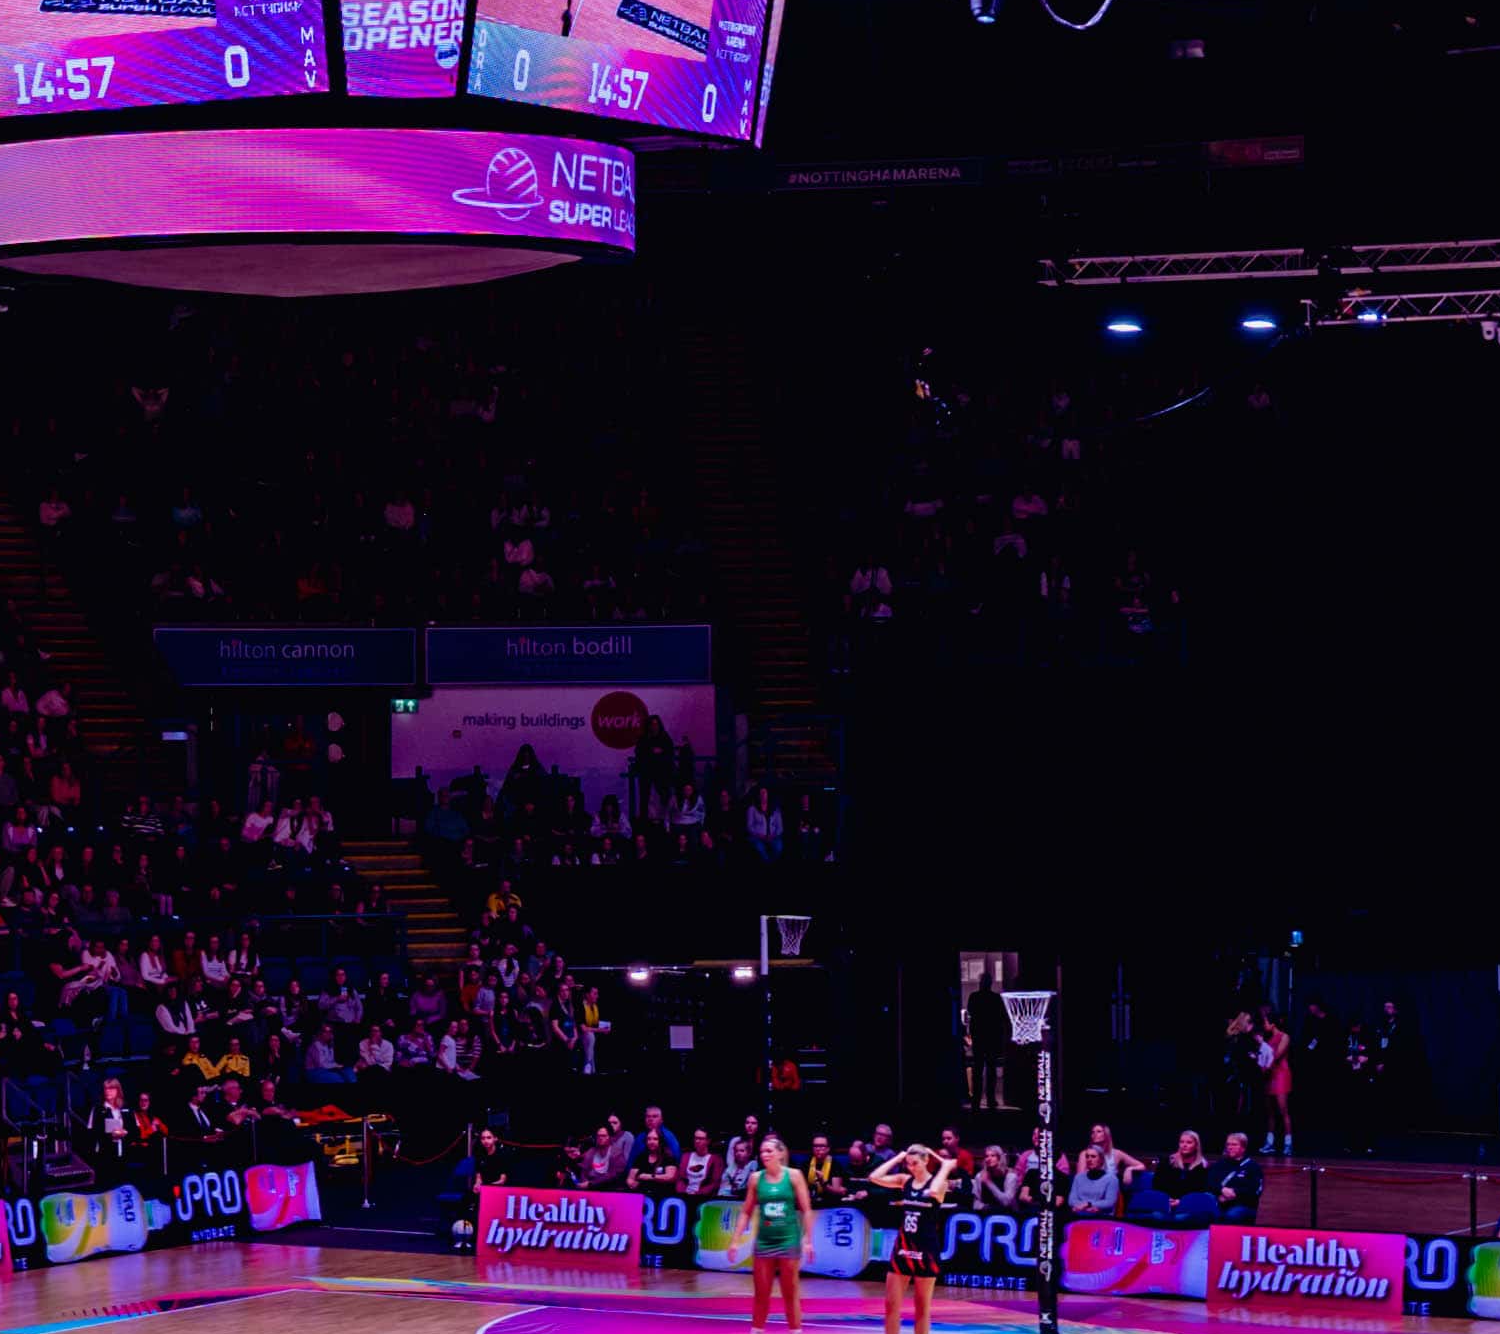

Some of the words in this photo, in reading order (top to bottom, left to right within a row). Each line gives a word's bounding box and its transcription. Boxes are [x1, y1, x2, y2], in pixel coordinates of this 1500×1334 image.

[342, 19, 465, 52] OPENER
[13, 56, 116, 105] 14:57
[223, 44, 251, 88] 0
[512, 49, 531, 92] 0
[586, 62, 650, 111] 14:57
[700, 83, 718, 123] 0
[786, 166, 961, 186] #NOTTINGHAMARENA
[548, 199, 612, 229] SUPER
[220, 639, 277, 660] hilton
[281, 643, 355, 660] cannon
[505, 635, 566, 656] hilton
[571, 635, 632, 656] bodill
[461, 713, 516, 729] making
[519, 711, 586, 729] buildings
[505, 1194, 608, 1225] Healthy
[485, 1222, 629, 1253] hydration
[1239, 1235, 1363, 1270] Healthy
[945, 1271, 1028, 1292] HYDRATE
[1217, 1260, 1389, 1303] hydration
